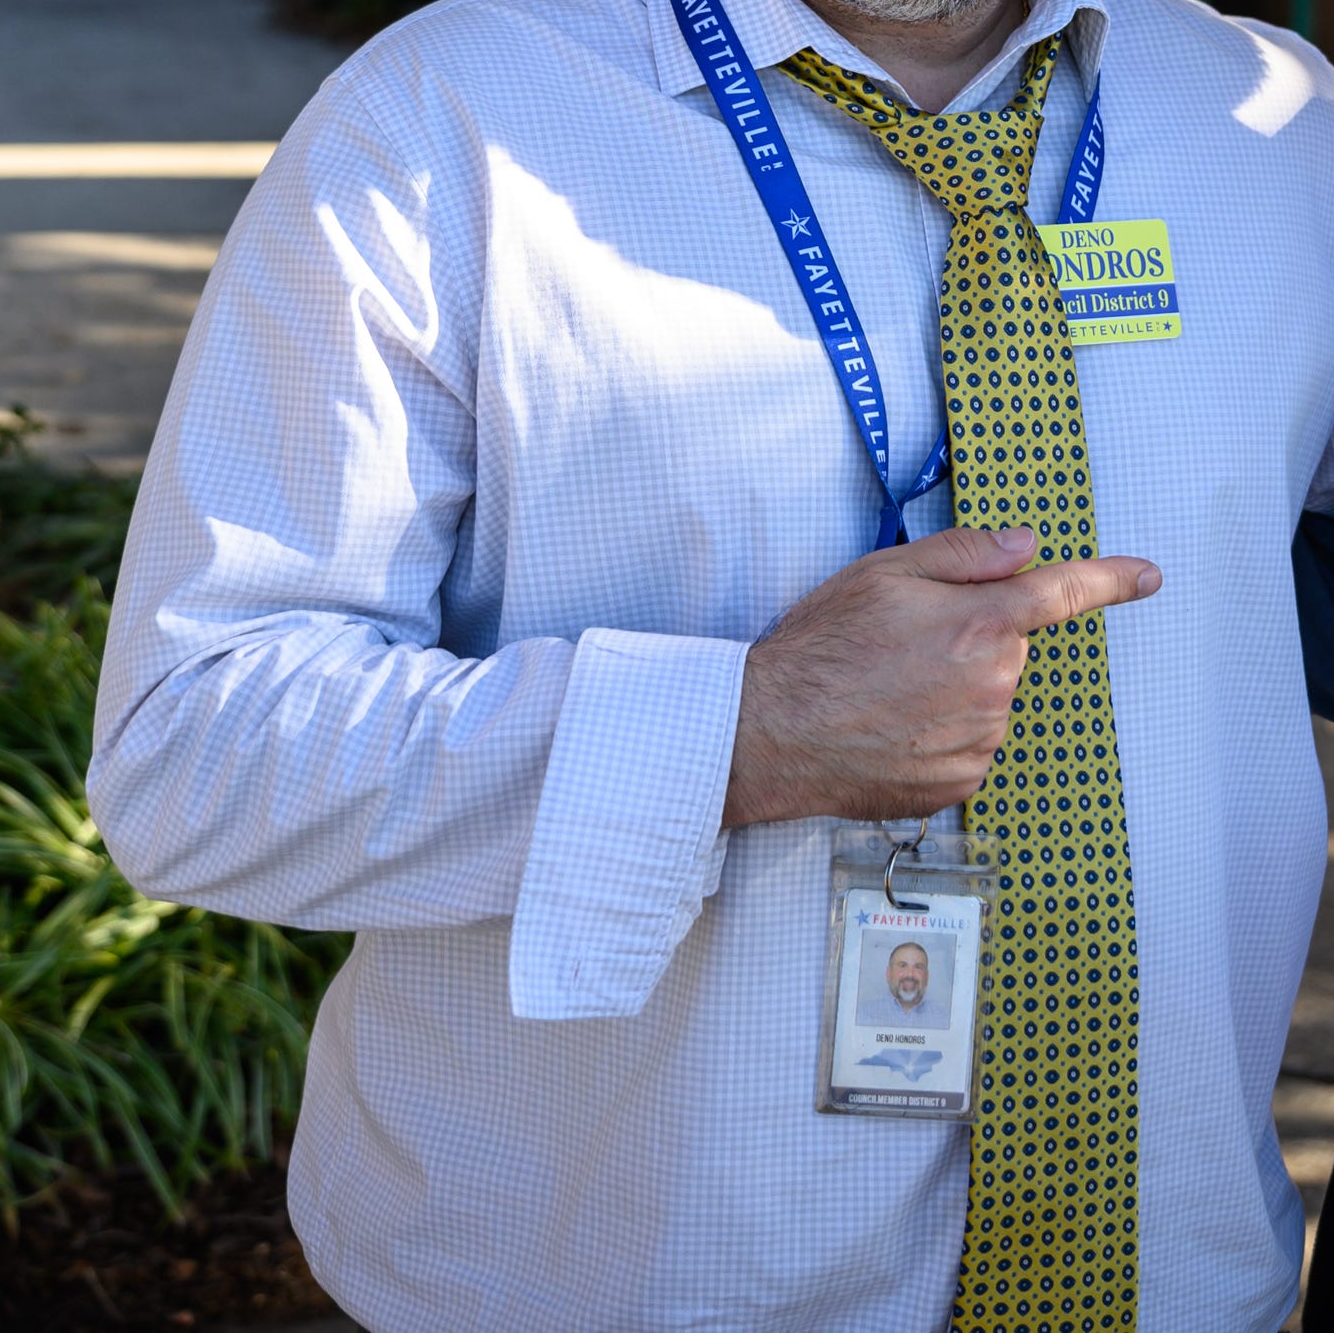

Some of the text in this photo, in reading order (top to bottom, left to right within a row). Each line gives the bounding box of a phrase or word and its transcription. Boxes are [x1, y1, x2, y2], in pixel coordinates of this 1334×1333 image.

[1070, 99, 1102, 217] FAYETT
[1060, 228, 1114, 249] DENO
[1048, 247, 1165, 283] ONDROS
[1091, 290, 1156, 314] District
[1158, 288, 1170, 309] 9
[1070, 321, 1154, 338] ETTEVILLE
[798, 245, 886, 463] FAYETTEVILLE
[872, 913, 964, 930] FAYETTEVILLE
[875, 1033, 926, 1045] DENO HONDROS
[908, 1096, 940, 1107] DISTRICT
